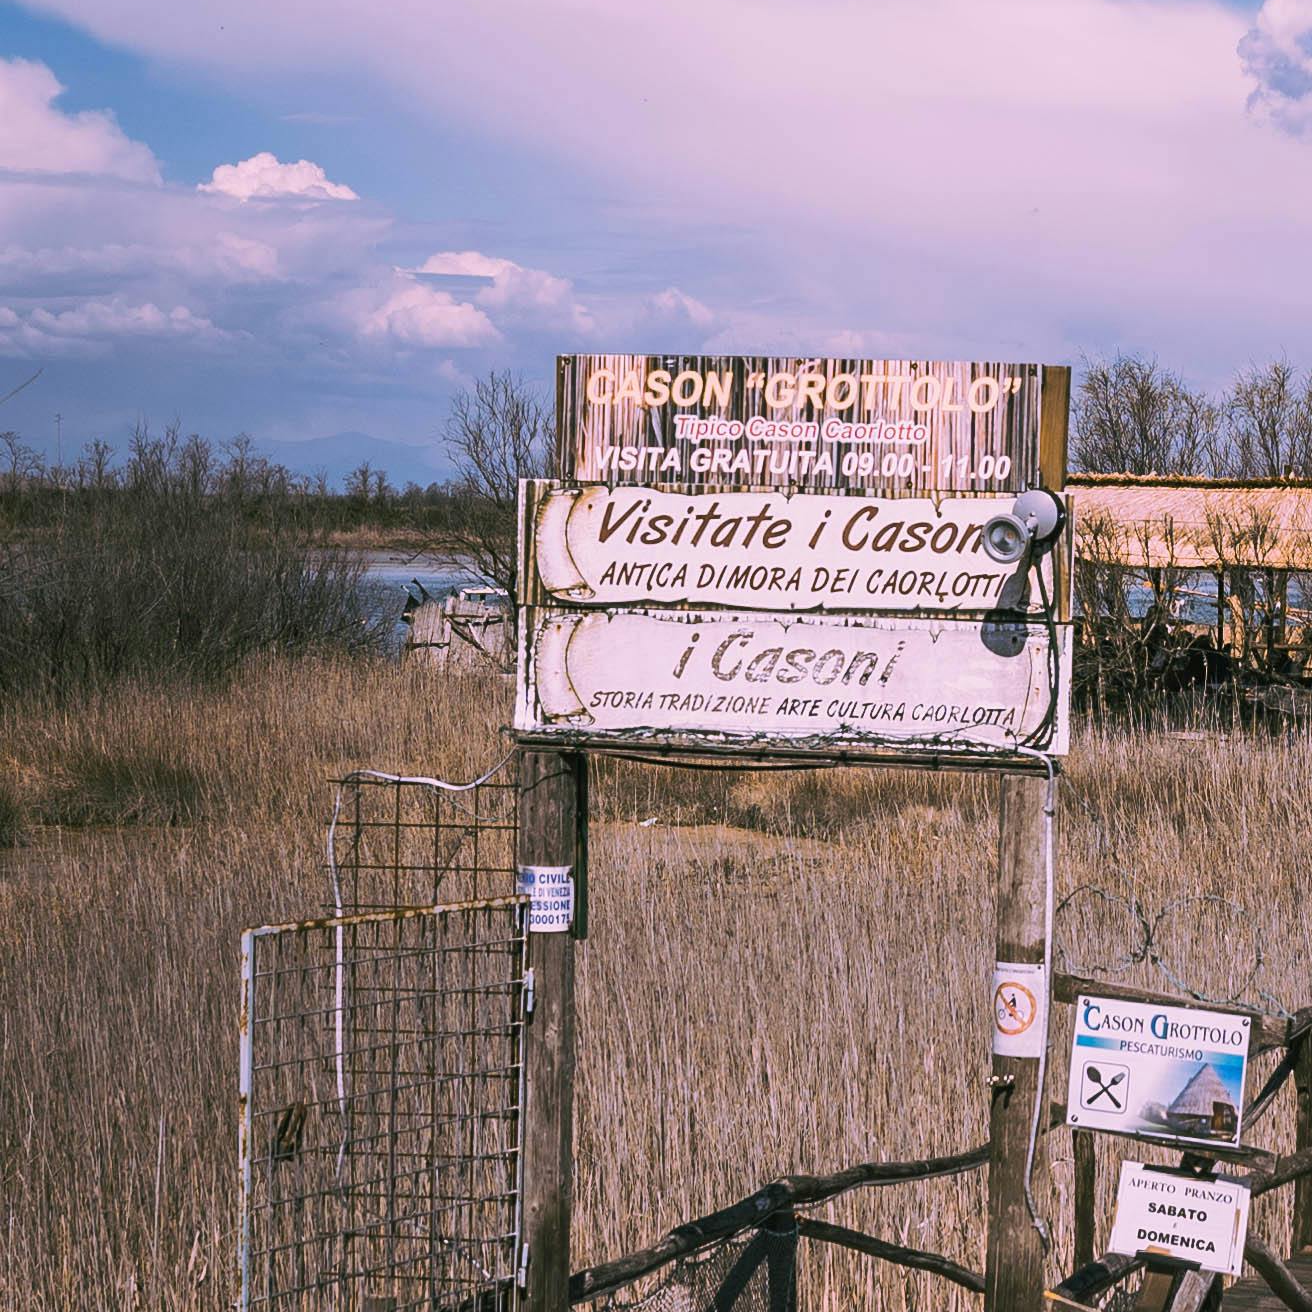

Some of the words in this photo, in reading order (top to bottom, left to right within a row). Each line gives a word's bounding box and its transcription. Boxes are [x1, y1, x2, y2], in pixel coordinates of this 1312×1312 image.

[587, 368, 734, 408] CASON
[677, 417, 742, 440] Tipico
[749, 418, 818, 439] Cason
[825, 420, 927, 441] Caorlotto
[595, 445, 682, 472] VISITA
[690, 447, 834, 475] GRATUITA
[841, 451, 915, 478] 09.00
[941, 453, 1012, 480] 11.00
[598, 499, 793, 550] Visitate
[808, 509, 832, 550] i
[842, 505, 985, 555] Cason
[600, 561, 688, 591] ANTICA
[697, 563, 803, 592] DIMORA
[811, 567, 860, 593] DEI
[866, 569, 1007, 599] CAORLOTTI
[672, 632, 701, 679] i
[711, 629, 906, 688] Casoni
[590, 691, 655, 710] STORIA
[659, 694, 772, 715] TRADIZIONE
[776, 698, 823, 718] ARTE
[827, 700, 907, 722] CULTURA
[911, 704, 1017, 726] CAORLOTTA
[539, 873, 570, 884] CIVILE
[1083, 1005, 1145, 1034] CASON
[1150, 1014, 1243, 1047] GROTTOLO
[1119, 1039, 1204, 1061] PESCATURISMO
[1128, 1177, 1176, 1194] APERTO
[1184, 1186, 1233, 1205] PRANZO
[1148, 1202, 1208, 1222] SABATO
[1137, 1228, 1216, 1253] DOMENICA
